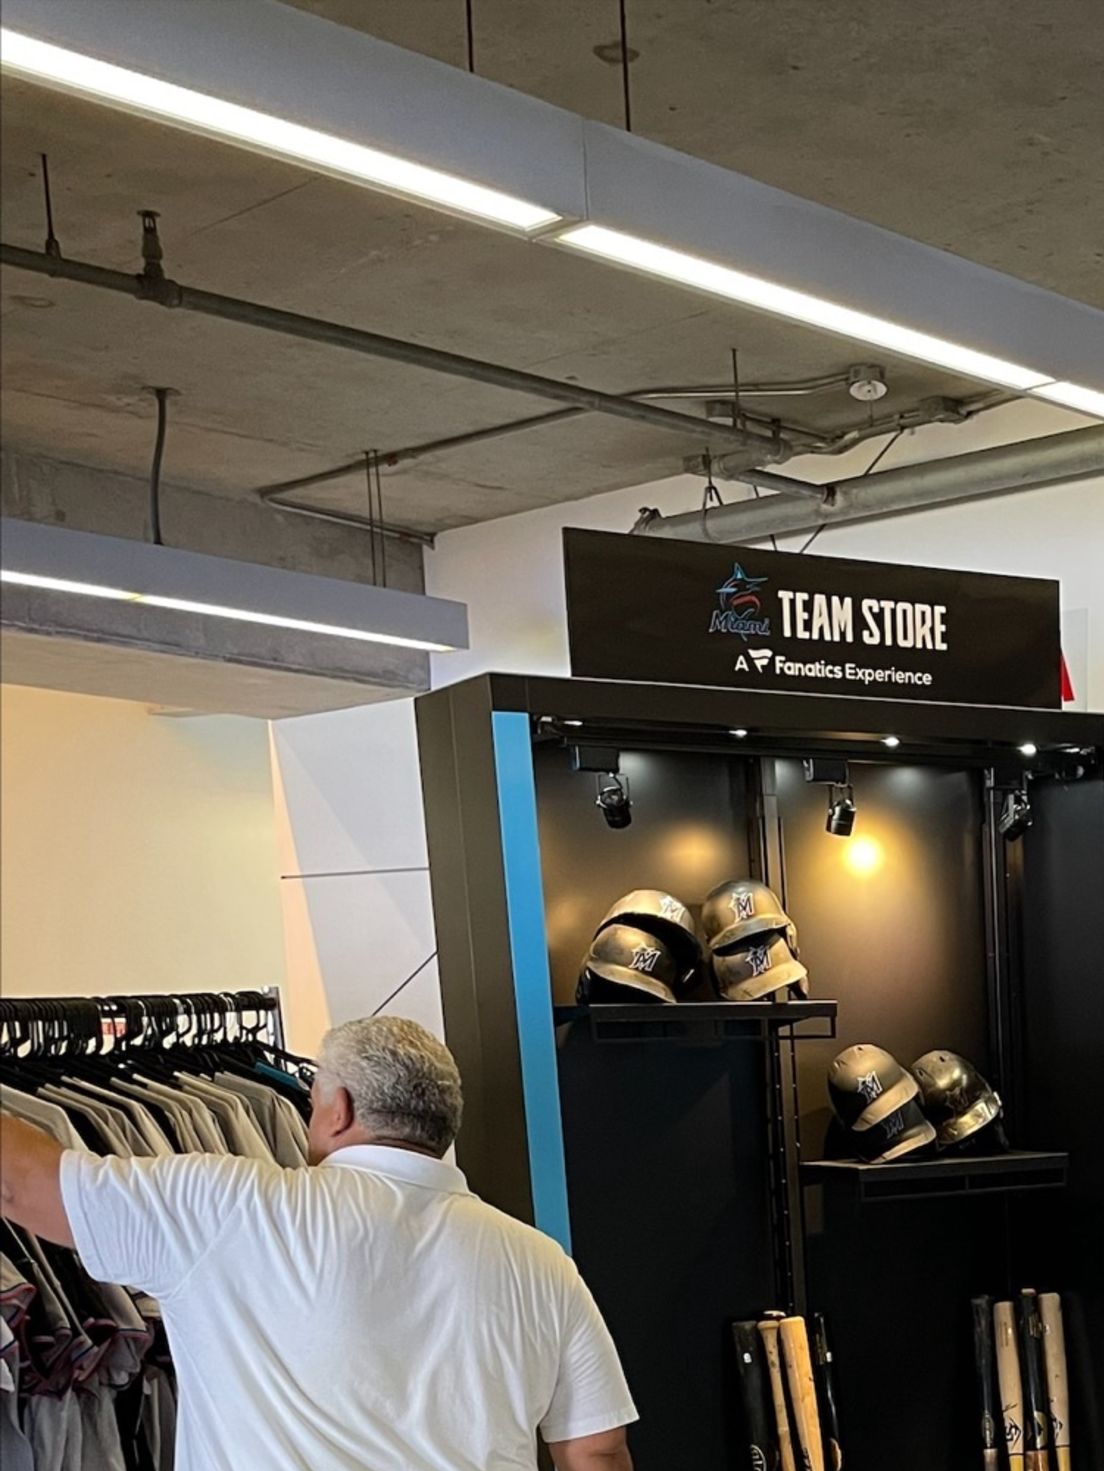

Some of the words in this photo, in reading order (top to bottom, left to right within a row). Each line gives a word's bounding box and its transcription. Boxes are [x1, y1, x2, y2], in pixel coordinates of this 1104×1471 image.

[709, 610, 771, 637] Miami
[778, 590, 854, 643] TEAM
[862, 599, 948, 651] STORE
[734, 655, 749, 672] A
[775, 656, 843, 679] Fanatics
[845, 663, 933, 685] Experience
